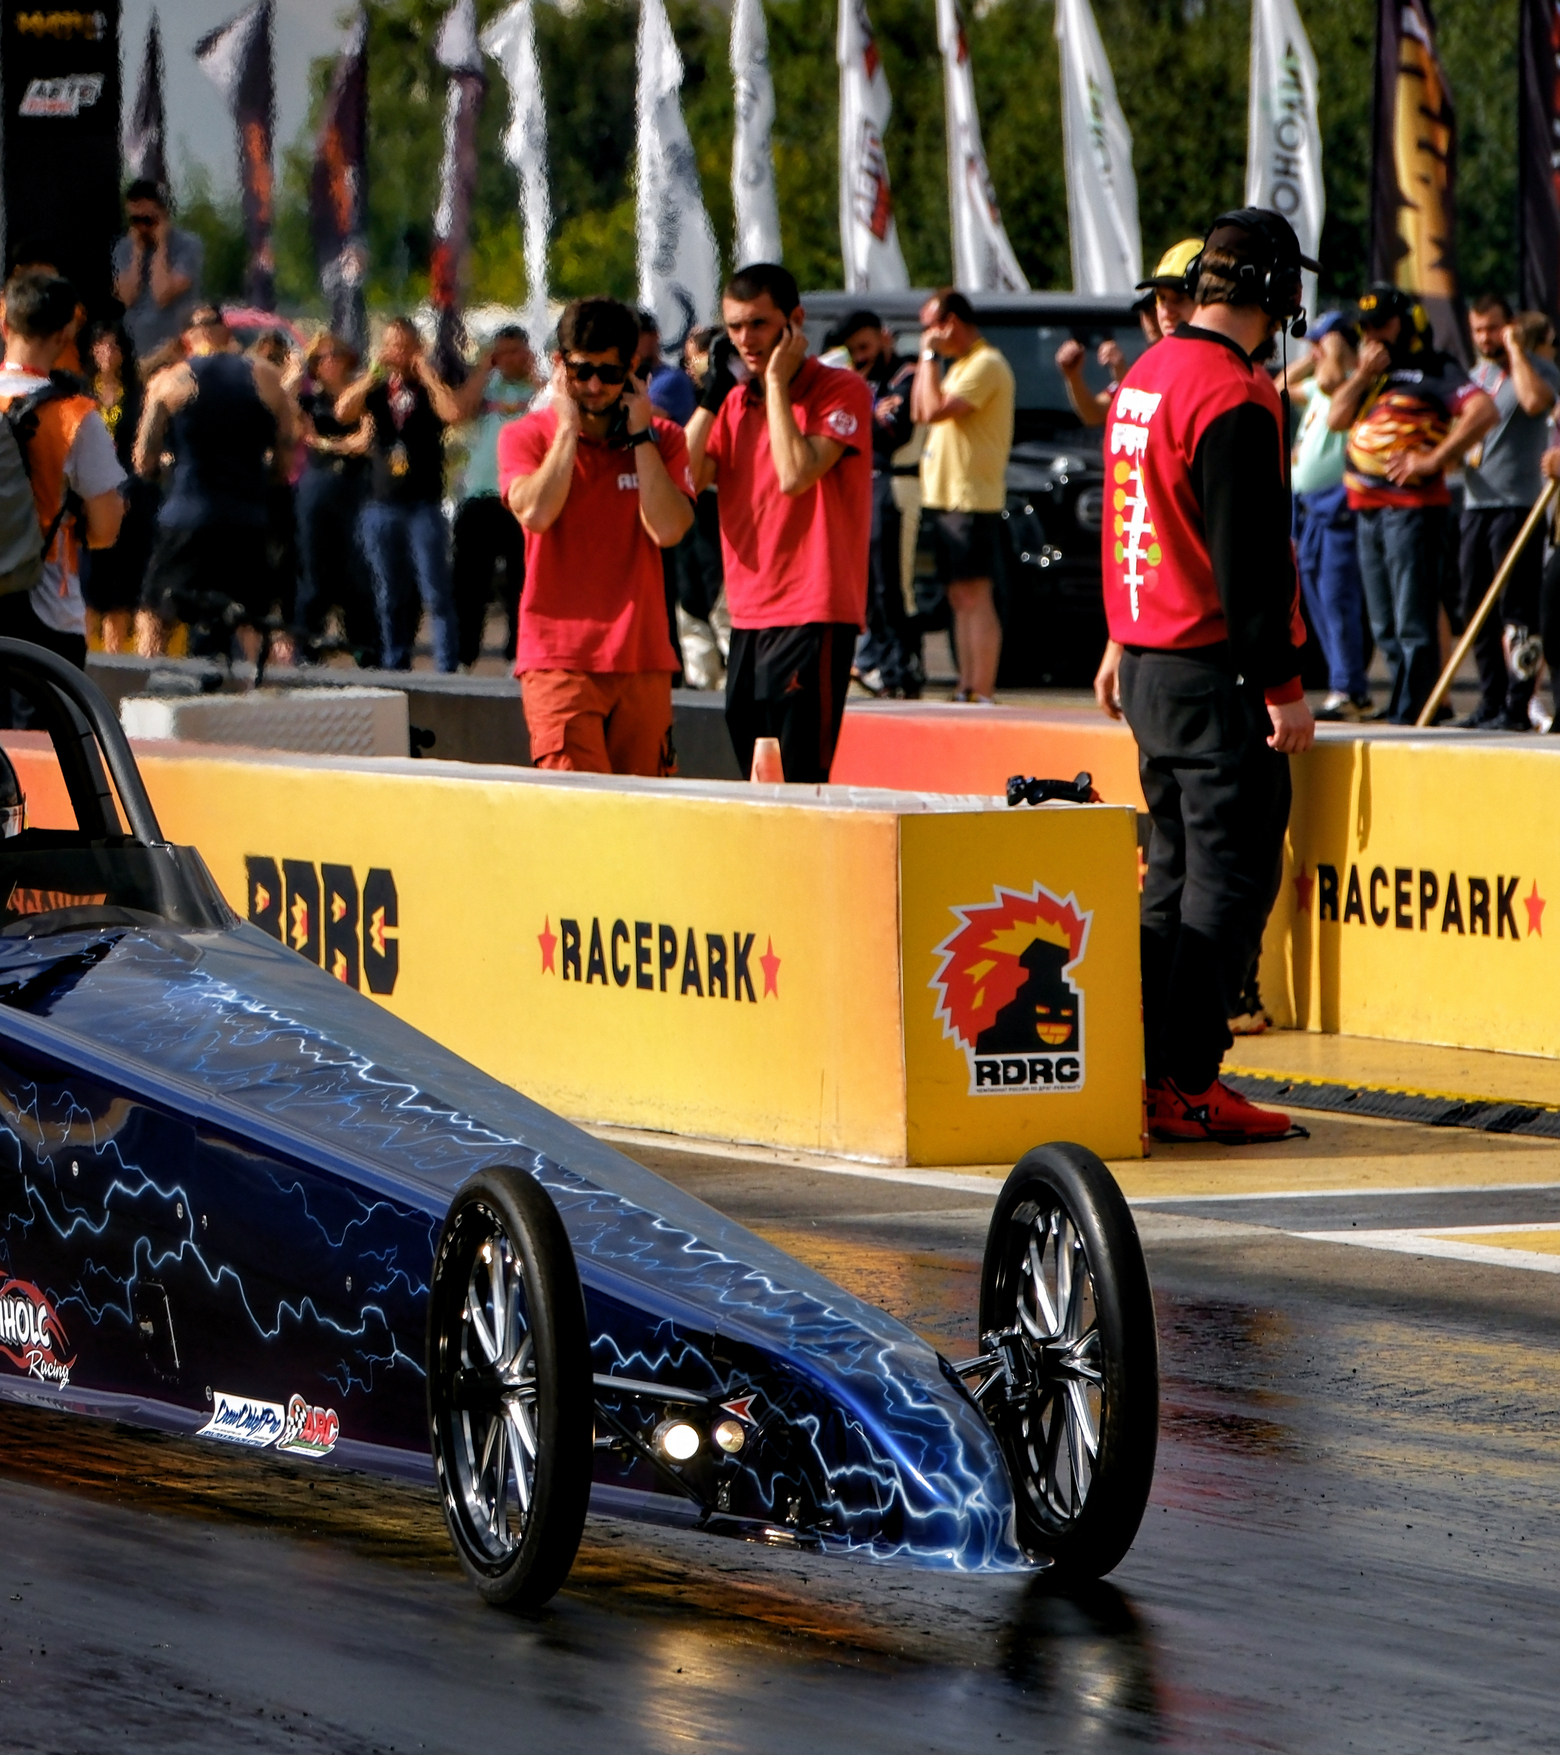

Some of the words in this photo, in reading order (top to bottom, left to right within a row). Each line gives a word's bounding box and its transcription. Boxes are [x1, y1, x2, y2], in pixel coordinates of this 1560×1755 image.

[1317, 863, 1521, 942] RACEPARK
[560, 916, 758, 1004] RACEPARK
[974, 1057, 1080, 1086] RDRC
[25, 1349, 70, 1391] Racing
[299, 1406, 339, 1446] ARC
